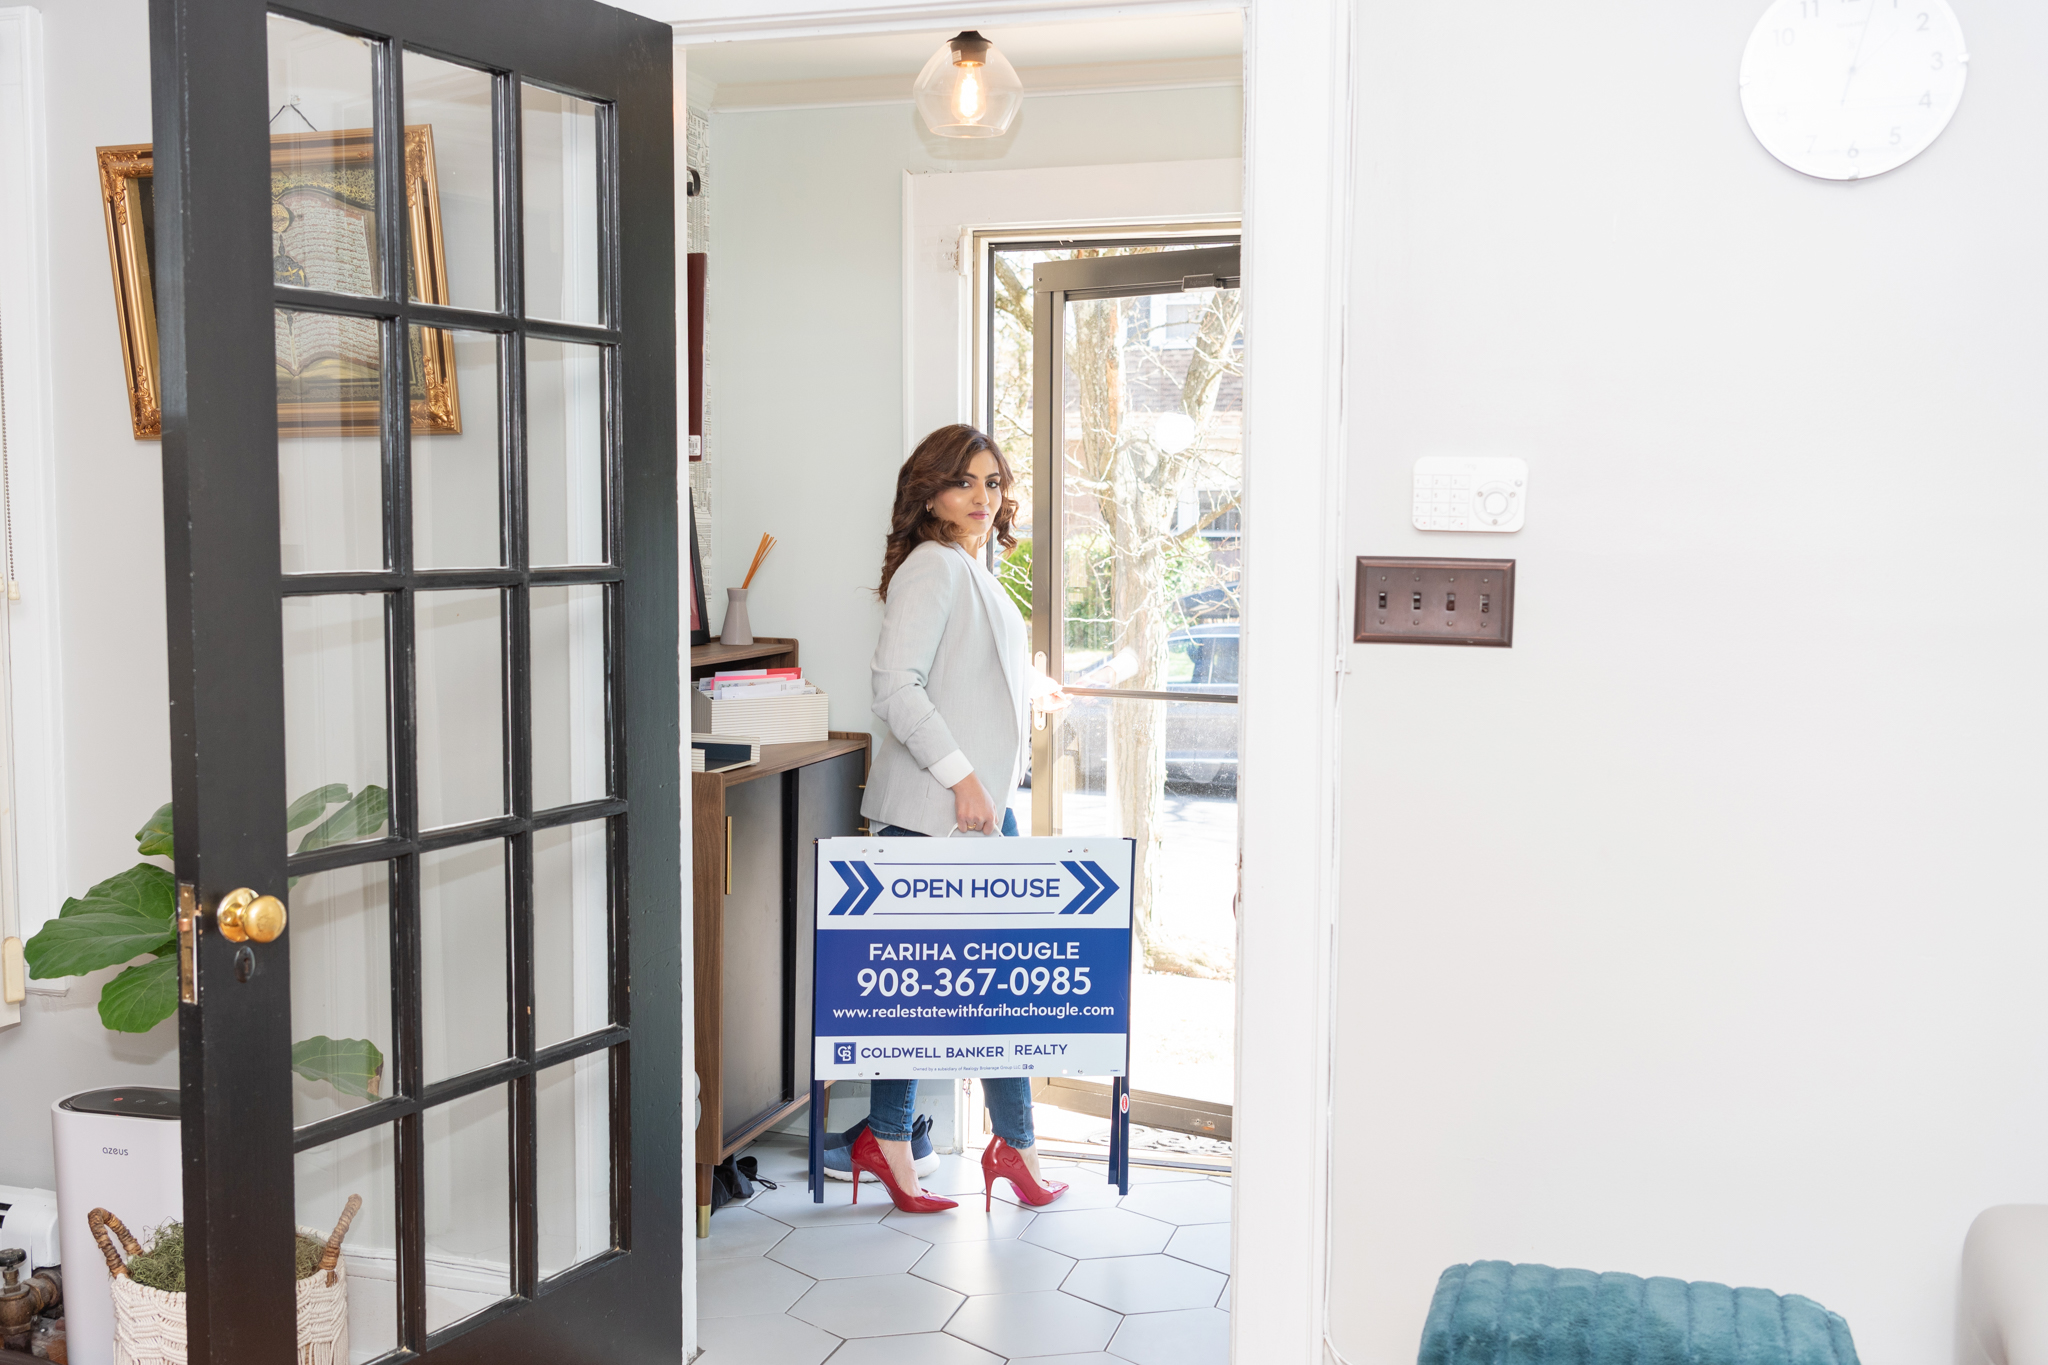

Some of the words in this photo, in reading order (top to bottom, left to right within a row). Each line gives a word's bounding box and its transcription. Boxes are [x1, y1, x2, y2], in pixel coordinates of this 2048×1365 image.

[1800, 0, 1819, 19] 11
[1916, 11, 1930, 32] 2
[1772, 27, 1796, 47] 10
[1930, 51, 1944, 71] 3
[1918, 89, 1933, 109] 4
[1805, 134, 1818, 154] 7
[1888, 126, 1902, 146] 5
[1847, 139, 1860, 159] 6
[891, 878, 963, 899] OPEN
[971, 878, 1061, 898] HOUSE
[869, 943, 957, 961] FARIHA
[963, 941, 1080, 961] CHOUGLE
[857, 966, 1092, 997] 908-367-0985
[832, 1002, 1115, 1019] www.realestatewithfarihachougle.com
[860, 1047, 941, 1059] COLDWELL
[946, 1046, 1004, 1058] BANKER
[1014, 1044, 1068, 1056] REALTY
[102, 1146, 129, 1156] azeus
